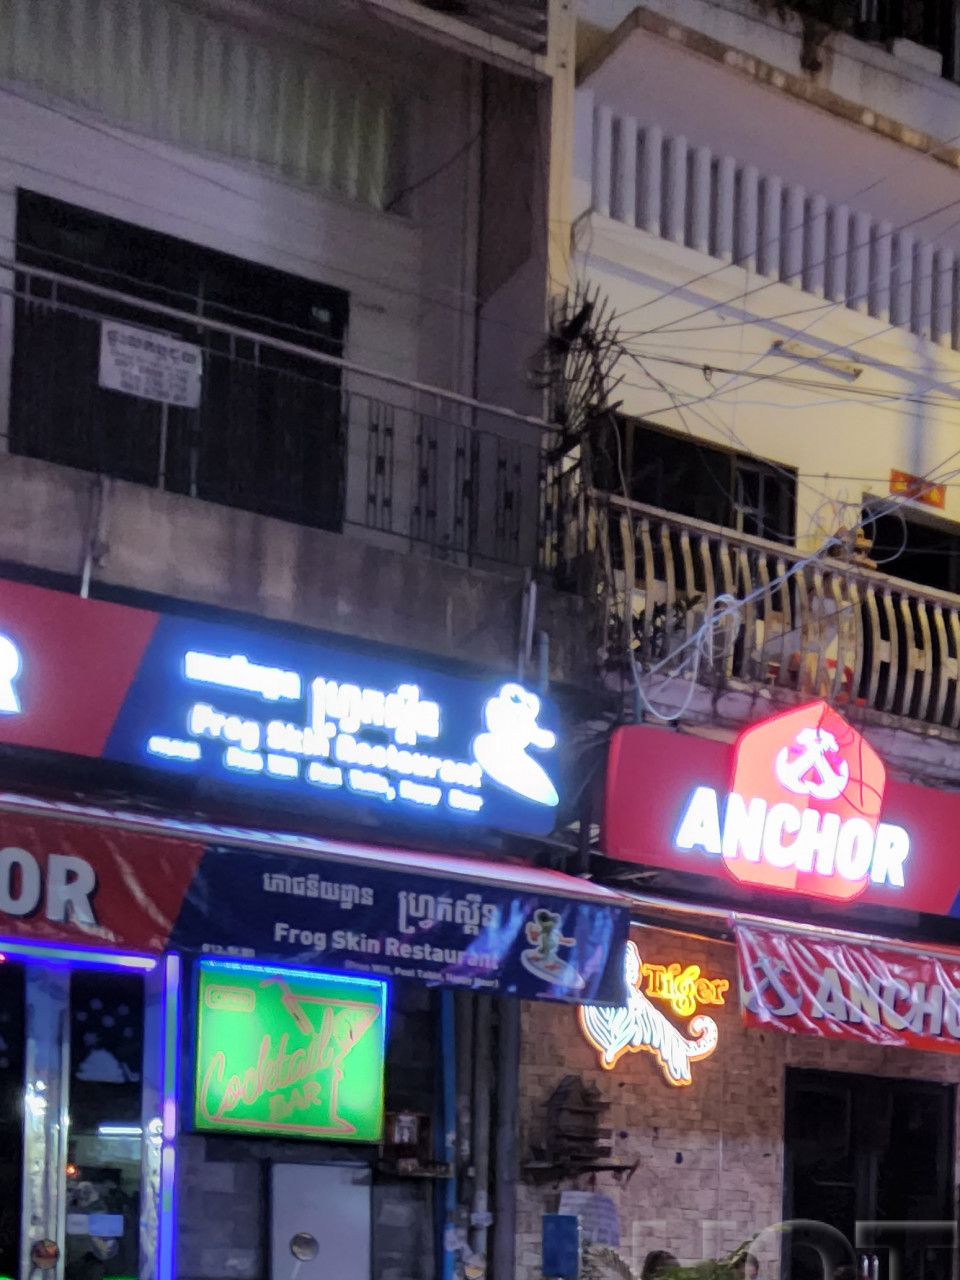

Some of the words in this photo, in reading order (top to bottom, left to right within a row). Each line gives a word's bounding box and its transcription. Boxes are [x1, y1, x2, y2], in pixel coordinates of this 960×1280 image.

[675, 786, 911, 887] ANCHOR
[273, 922, 328, 952] Frog
[331, 930, 380, 955] Skin
[384, 937, 499, 970] Restaurant
[641, 962, 729, 1017] Tiger
[202, 1007, 335, 1119] Cocktail
[268, 1082, 322, 1121] BAR
